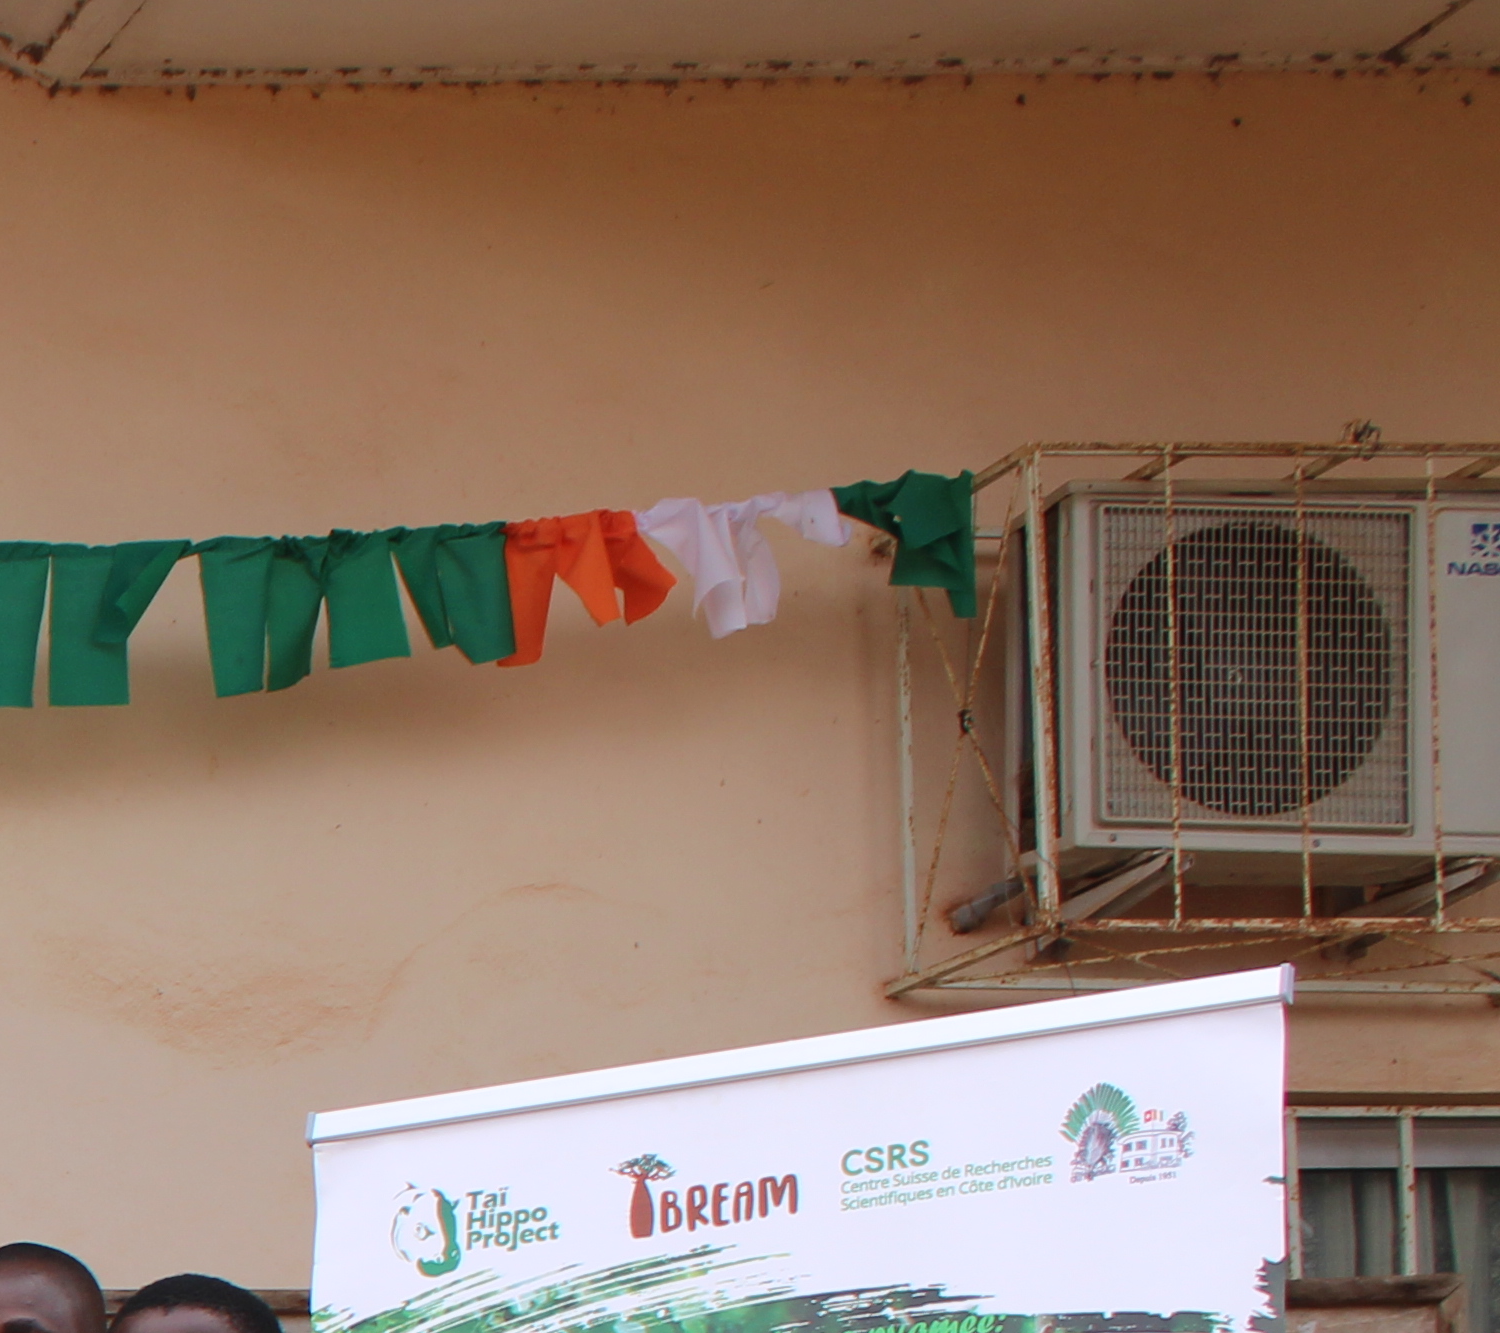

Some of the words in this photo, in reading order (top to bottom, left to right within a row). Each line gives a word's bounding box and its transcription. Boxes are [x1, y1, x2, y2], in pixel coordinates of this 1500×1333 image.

[840, 1140, 931, 1177] CSRS
[840, 1178, 889, 1194] Centre
[892, 1171, 938, 1187] Suisse
[941, 1166, 960, 1180] de
[964, 1155, 1052, 1176] Recherches
[467, 1187, 510, 1210] Taï
[840, 1188, 933, 1211] Scientifiques
[935, 1185, 954, 1197] en
[958, 1179, 994, 1194] Côte
[996, 1172, 1052, 1190] d'Ivoire
[467, 1205, 548, 1232] Hippo
[466, 1222, 561, 1251] Project
